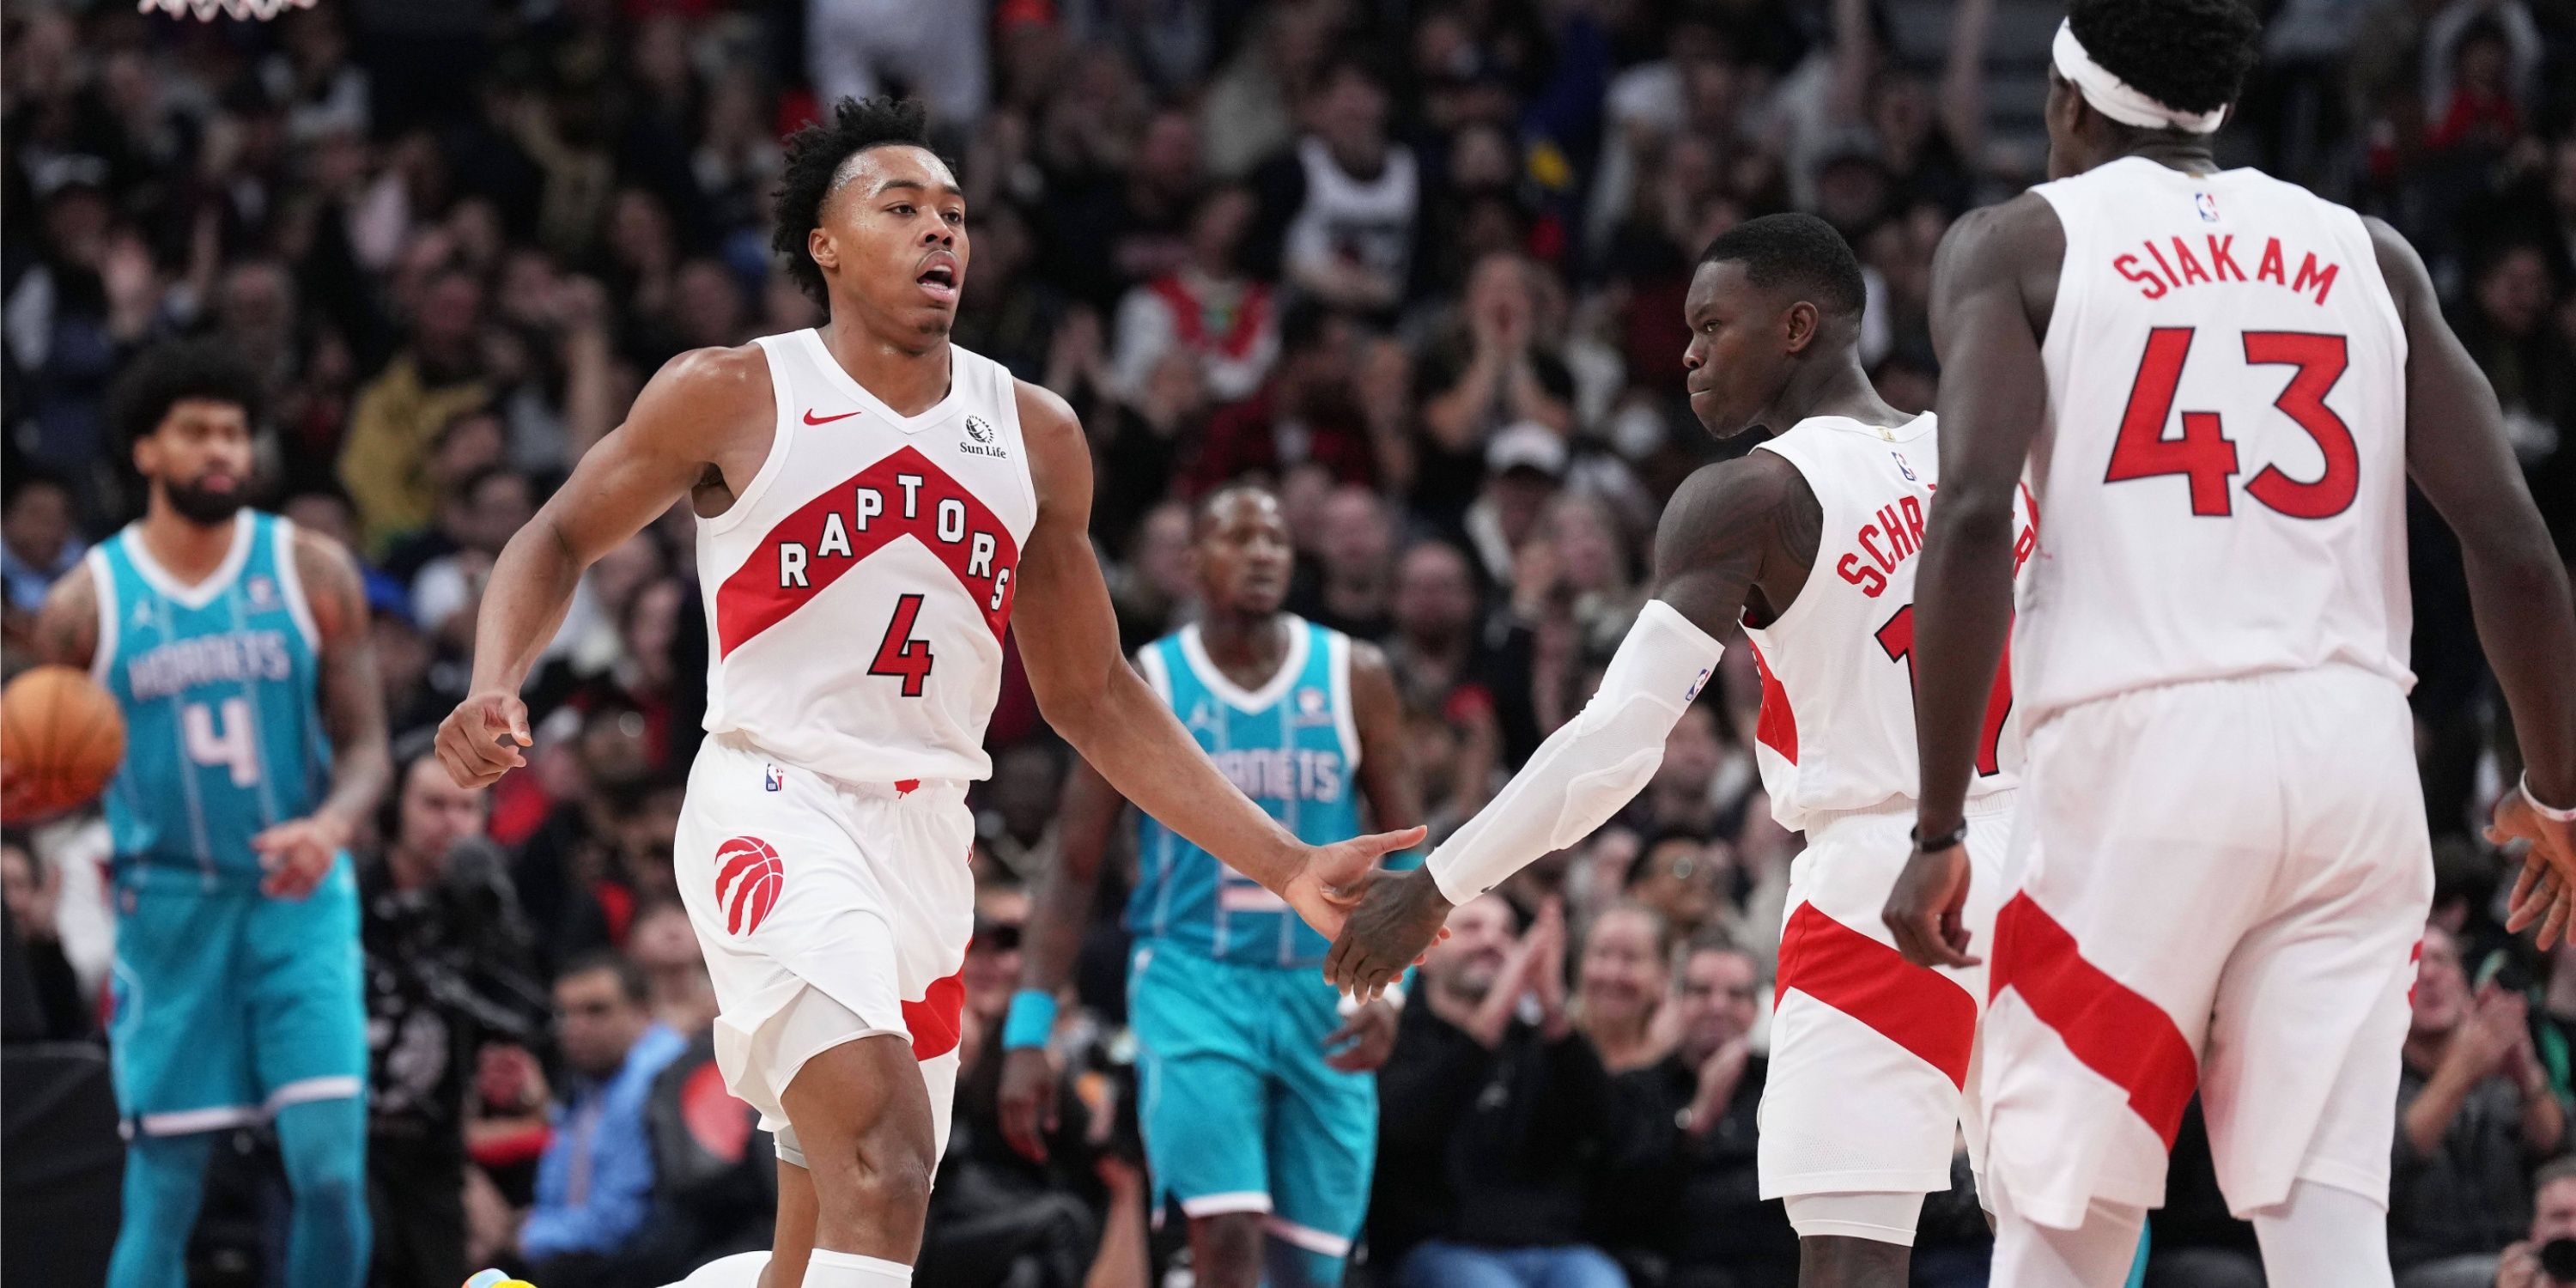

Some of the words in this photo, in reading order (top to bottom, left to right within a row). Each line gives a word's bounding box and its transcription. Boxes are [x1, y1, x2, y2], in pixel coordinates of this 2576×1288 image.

[2113, 234, 2340, 307] SIAKAM
[960, 441, 983, 455] Sun
[986, 445, 1006, 459] Life
[2104, 326, 2360, 519] 43
[779, 474, 1010, 611] RAPTORS
[1837, 483, 2036, 598] SCHRR
[866, 593, 934, 697] 4
[184, 698, 259, 788] 4
